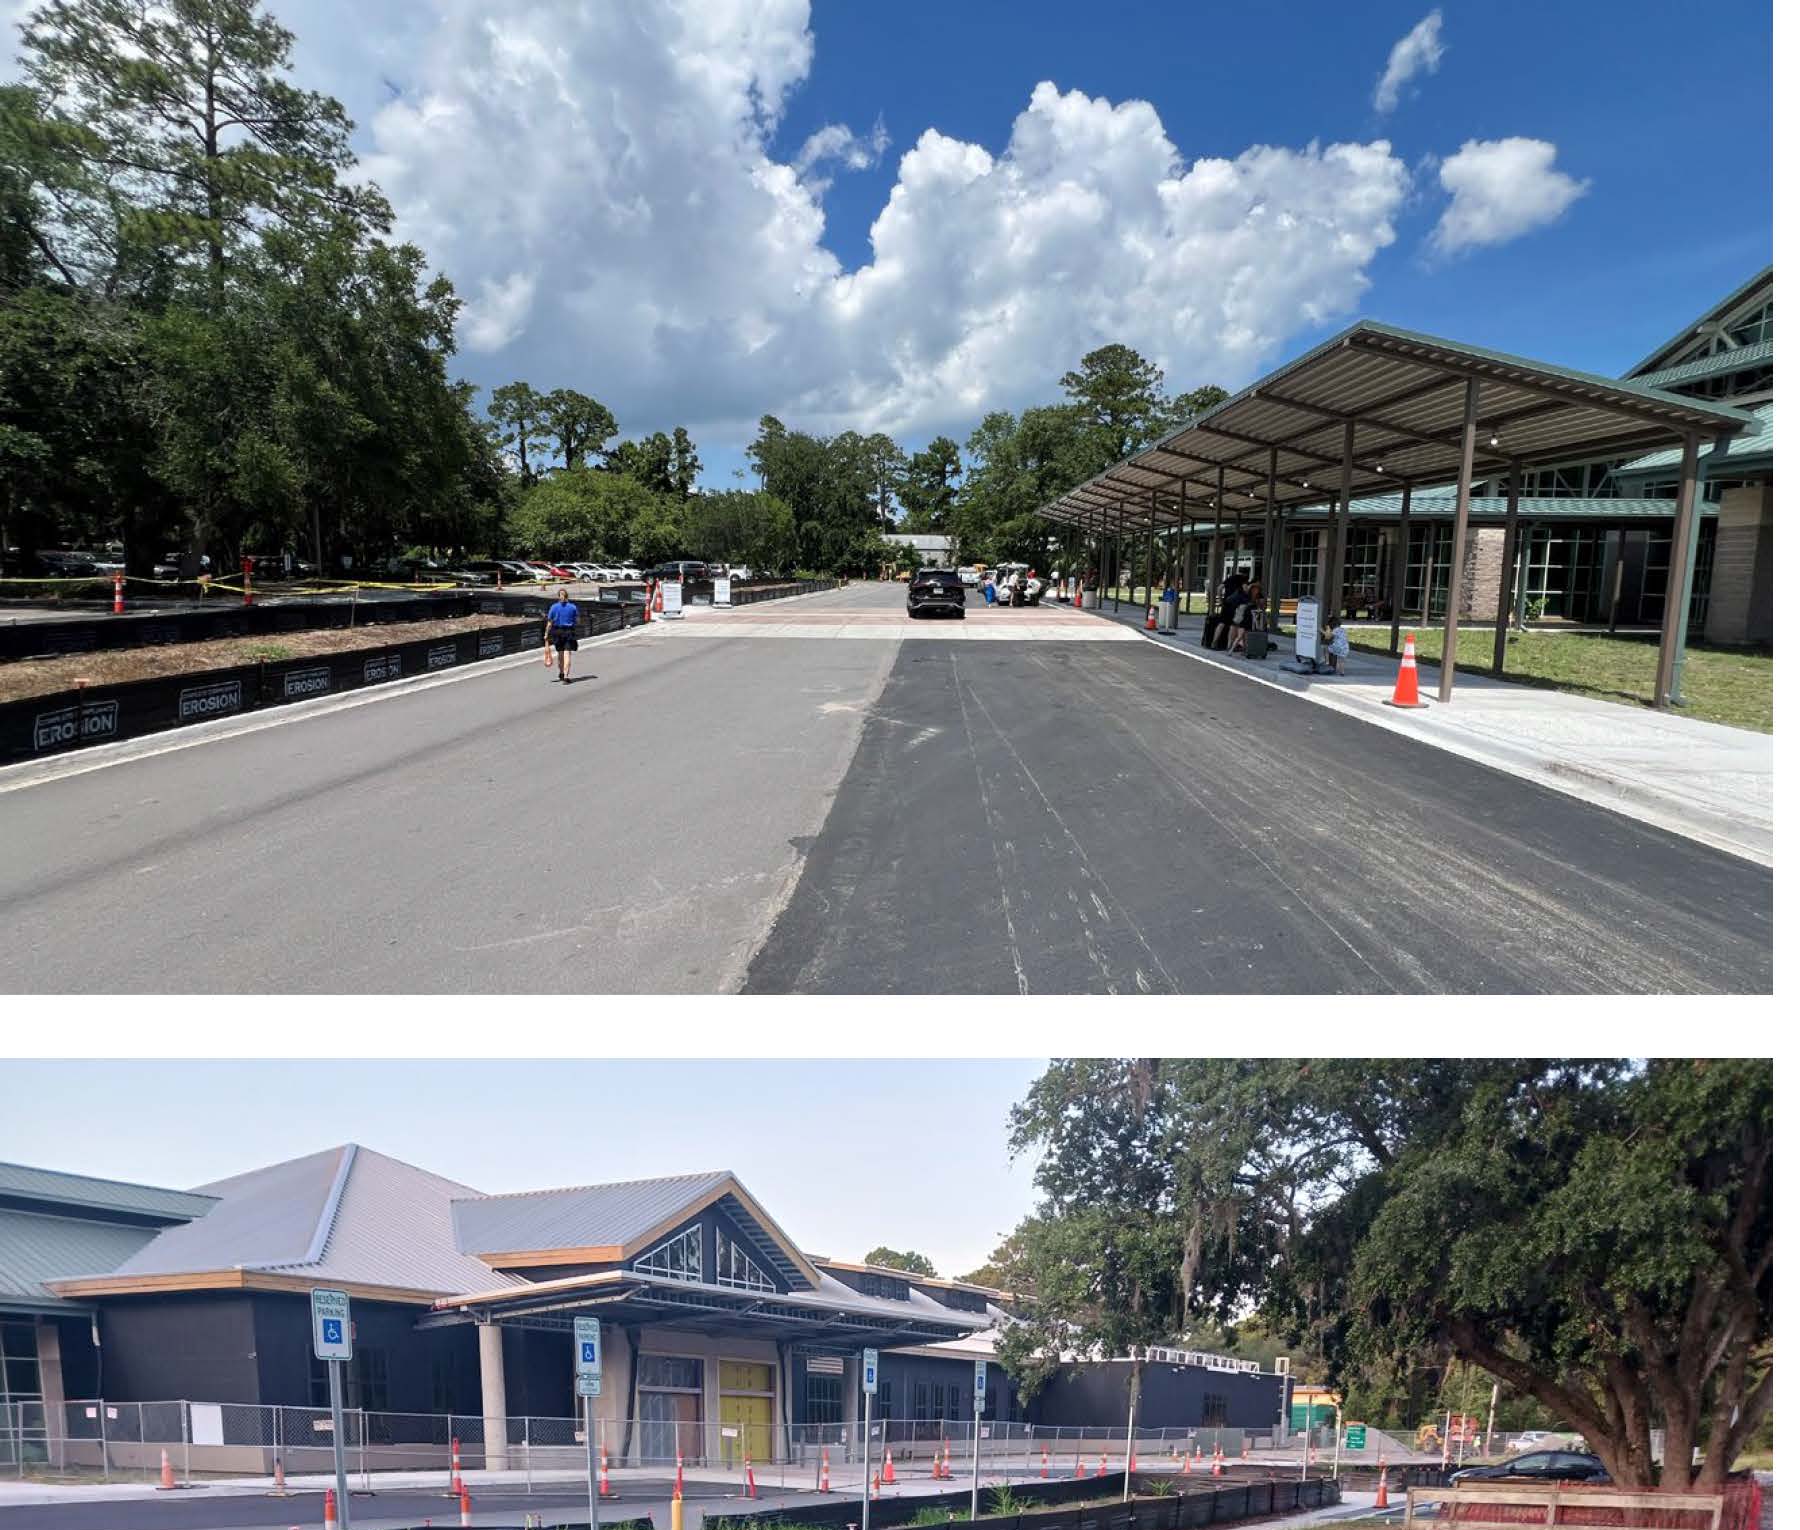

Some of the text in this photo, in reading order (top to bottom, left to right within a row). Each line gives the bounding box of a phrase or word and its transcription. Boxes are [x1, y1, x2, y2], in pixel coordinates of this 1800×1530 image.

[366, 664, 399, 682] EROSON
[287, 676, 327, 696] EROSION
[182, 690, 237, 715] EROSION
